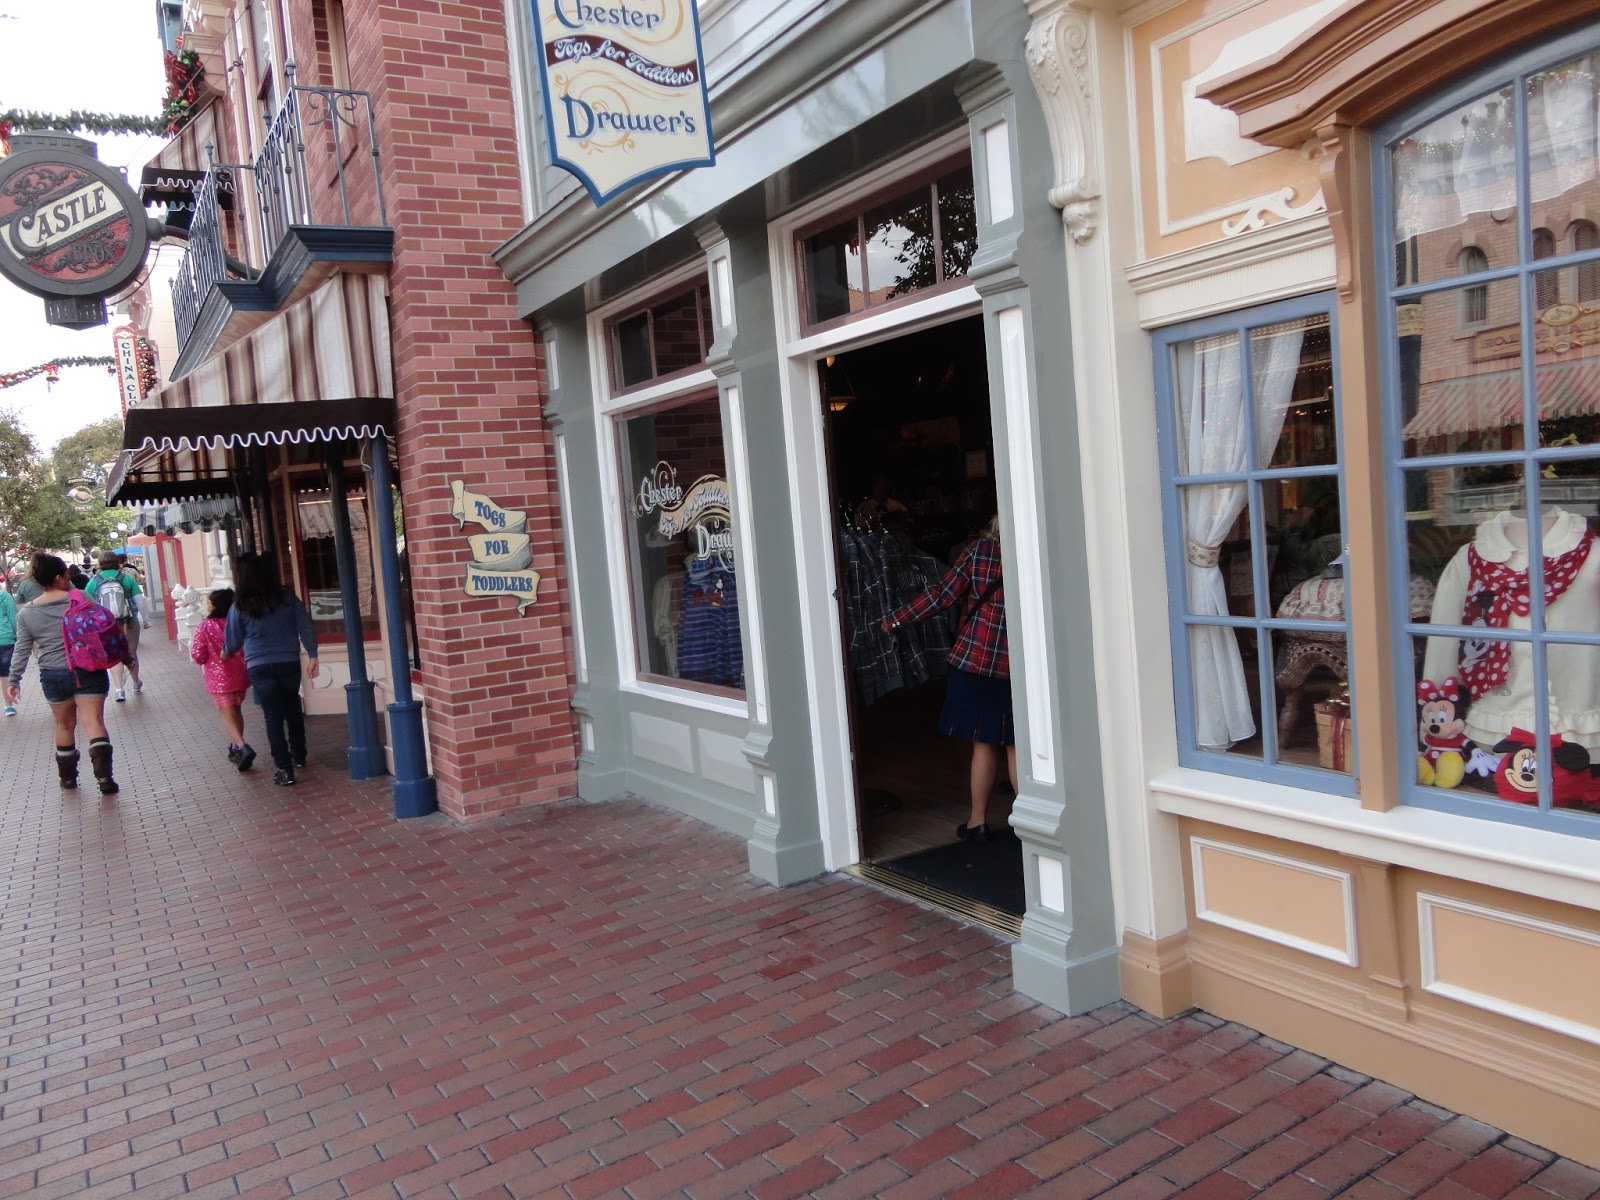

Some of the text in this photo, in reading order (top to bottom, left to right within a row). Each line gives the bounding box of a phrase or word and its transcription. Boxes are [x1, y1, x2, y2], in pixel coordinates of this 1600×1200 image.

[554, 0, 660, 29] Chester
[554, 37, 694, 85] Togs for Toddlers
[560, 93, 697, 139] Drawer's
[9, 185, 107, 256] CASTLE
[121, 342, 136, 381] CHINA
[474, 500, 506, 528] TOGS
[640, 476, 683, 514] Chester
[484, 539, 511, 556] FOR
[472, 574, 533, 592] TODDLERS
